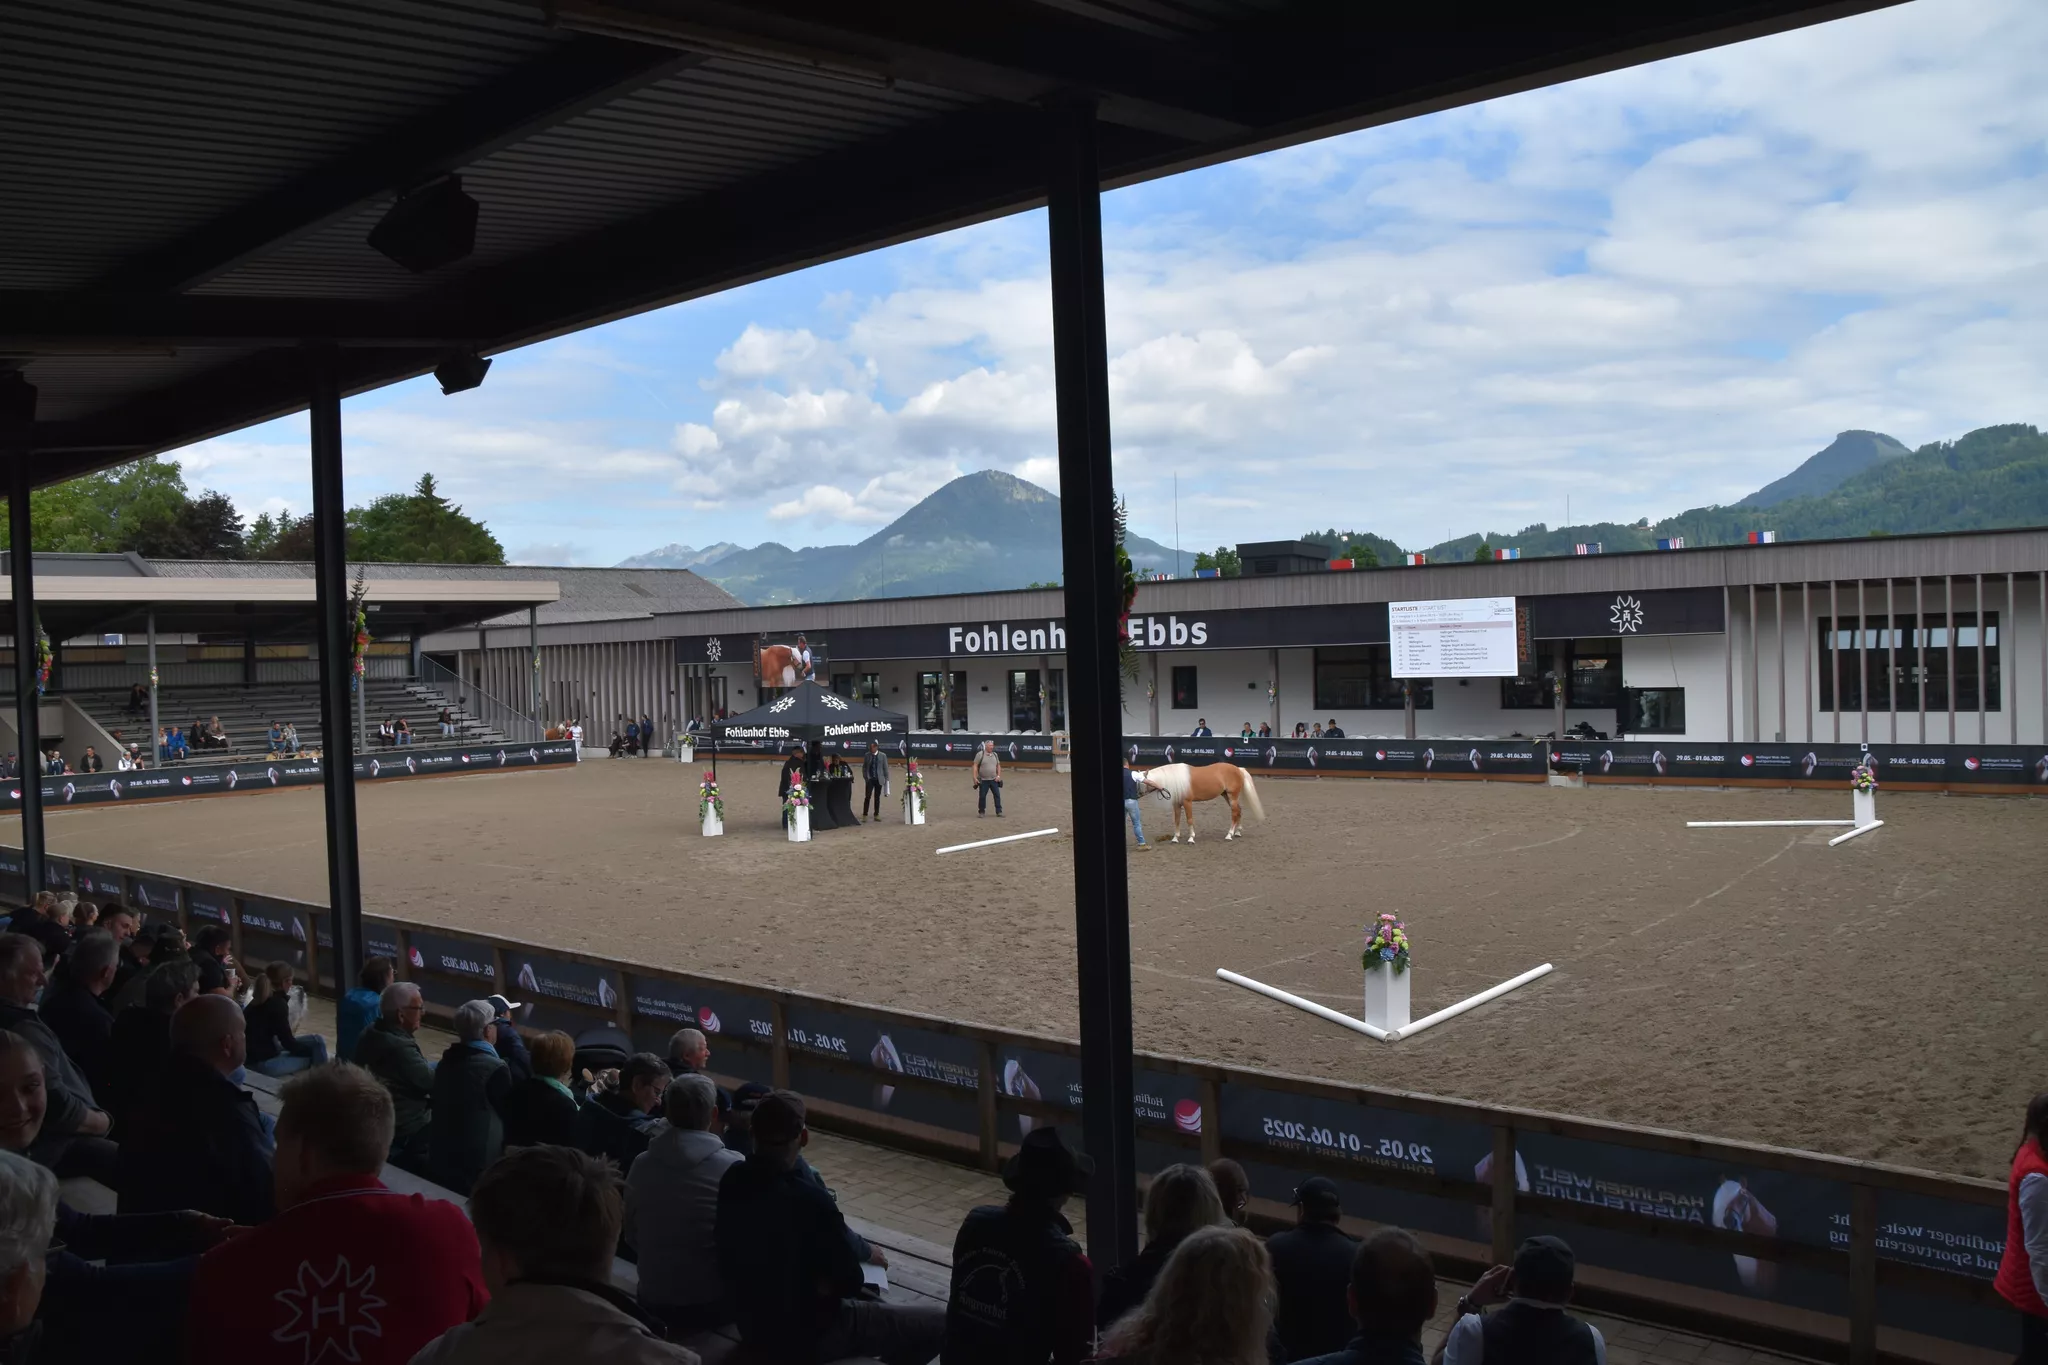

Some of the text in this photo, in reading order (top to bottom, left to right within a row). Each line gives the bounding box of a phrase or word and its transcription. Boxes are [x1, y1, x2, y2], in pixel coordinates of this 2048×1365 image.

[949, 616, 1208, 652] Fohlenh Ebbs
[725, 726, 790, 738] Fohlenhof Ebbs
[824, 721, 892, 736] Fohlenhof Ebbs
[312, 1292, 345, 1329] H
